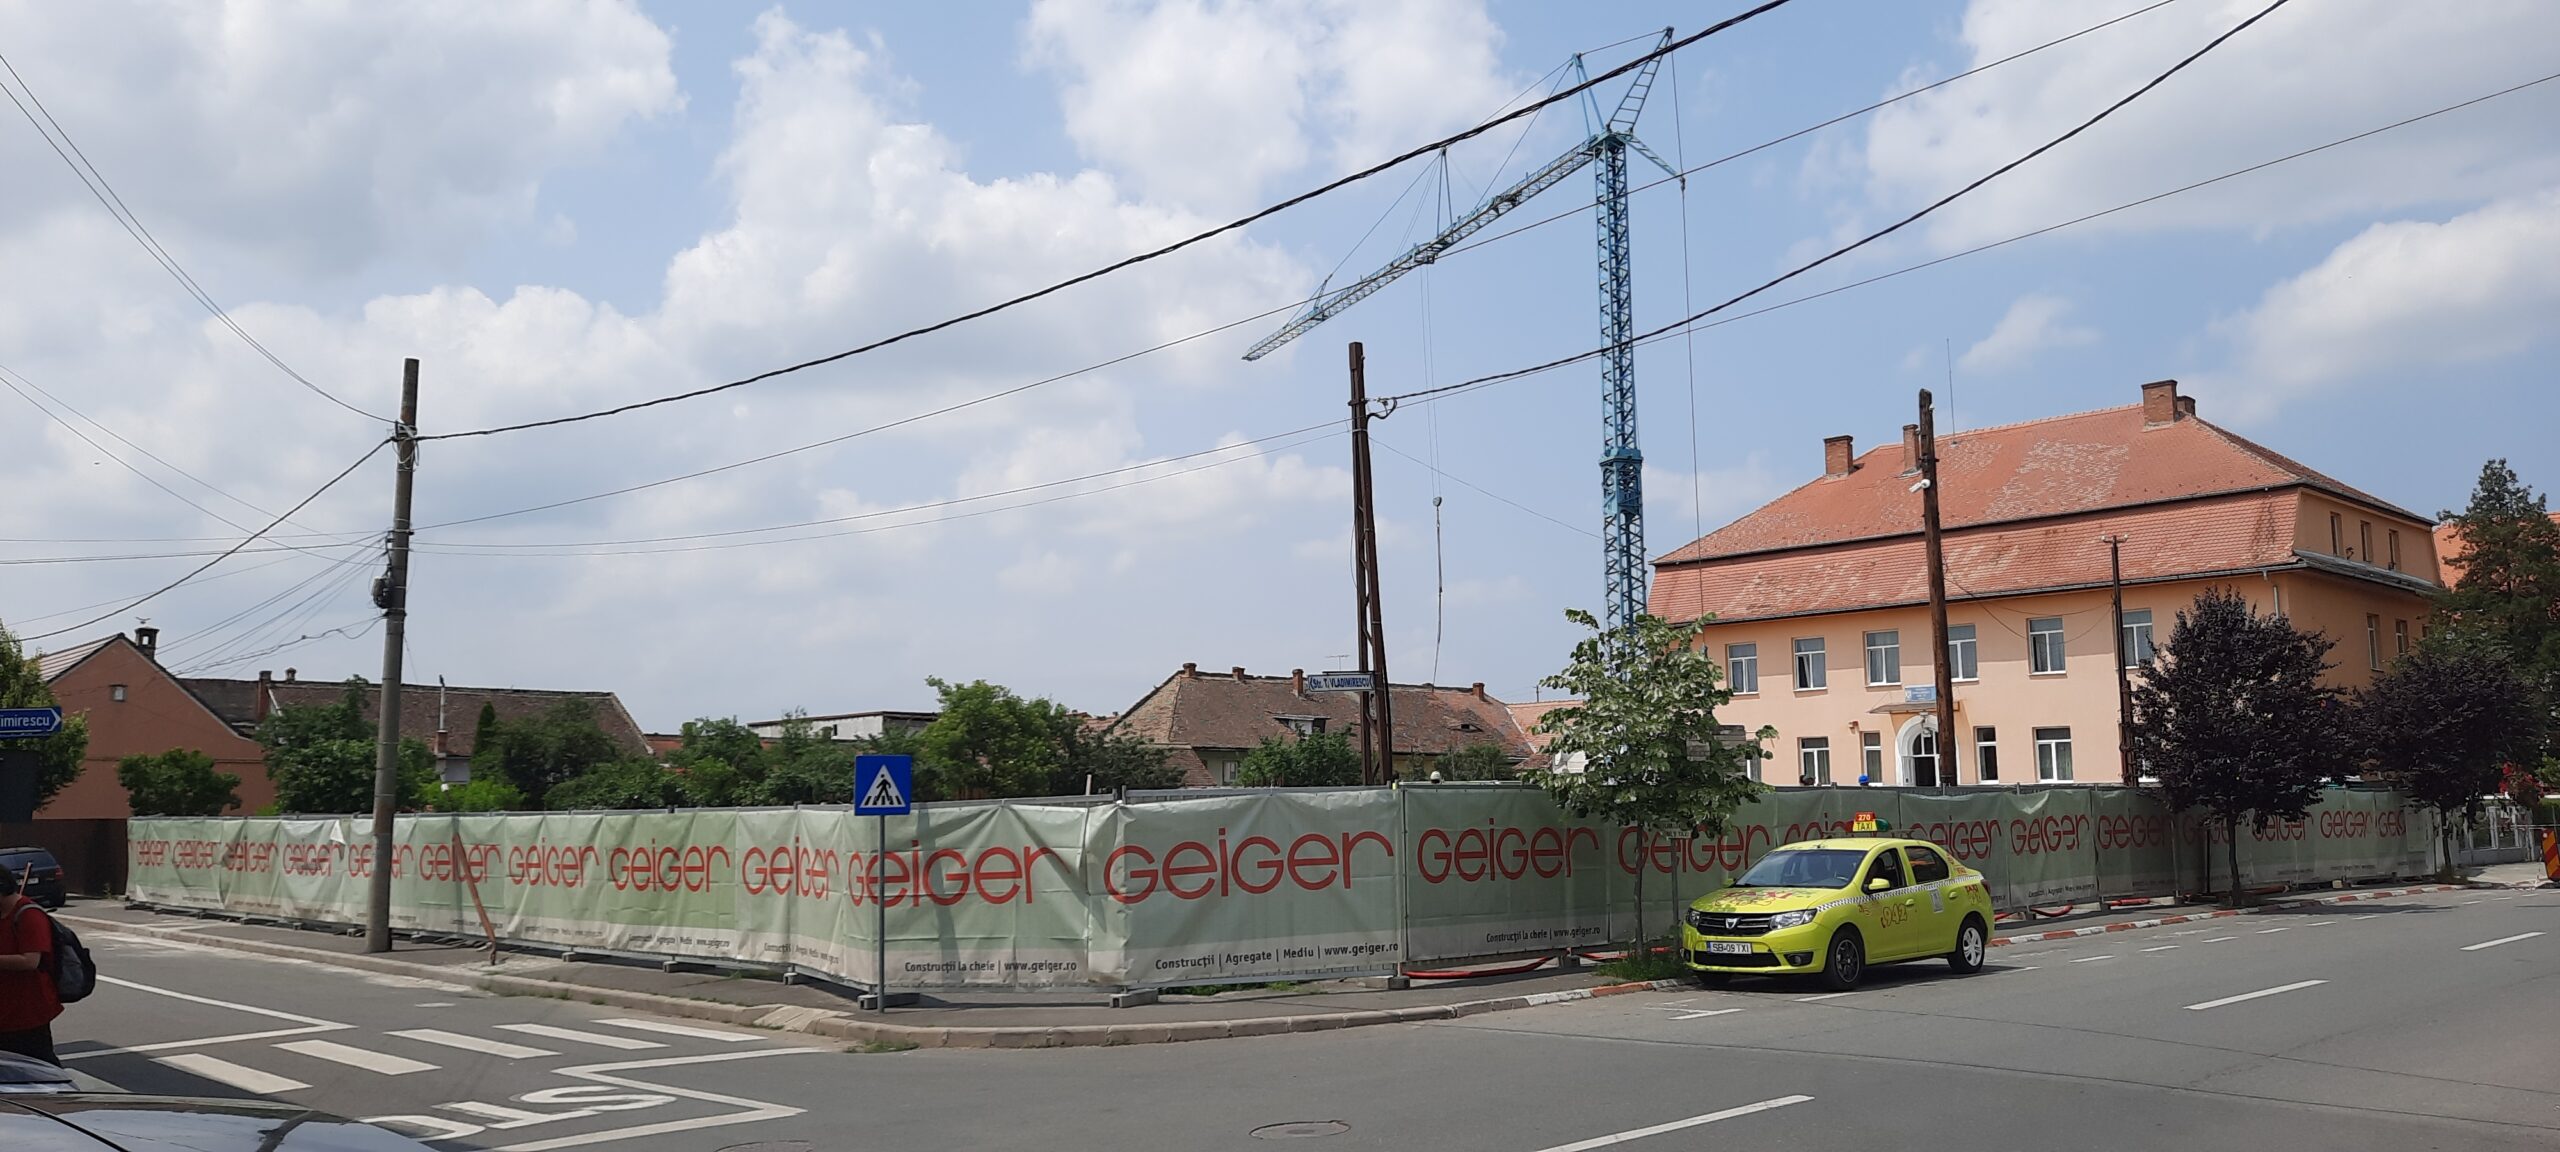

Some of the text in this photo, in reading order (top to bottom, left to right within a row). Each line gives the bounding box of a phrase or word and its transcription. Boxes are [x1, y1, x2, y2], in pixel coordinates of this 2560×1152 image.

[1856, 822, 1873, 831] TAXI
[1883, 903, 1908, 927] 942
[1225, 950, 1272, 966] Agregate
[1283, 947, 1314, 960] Mediu
[1324, 942, 1399, 958] www.geiger.ro
[958, 960, 967, 971] la
[969, 960, 995, 971] cheie
[1004, 959, 1078, 974] www.geiger.ro
